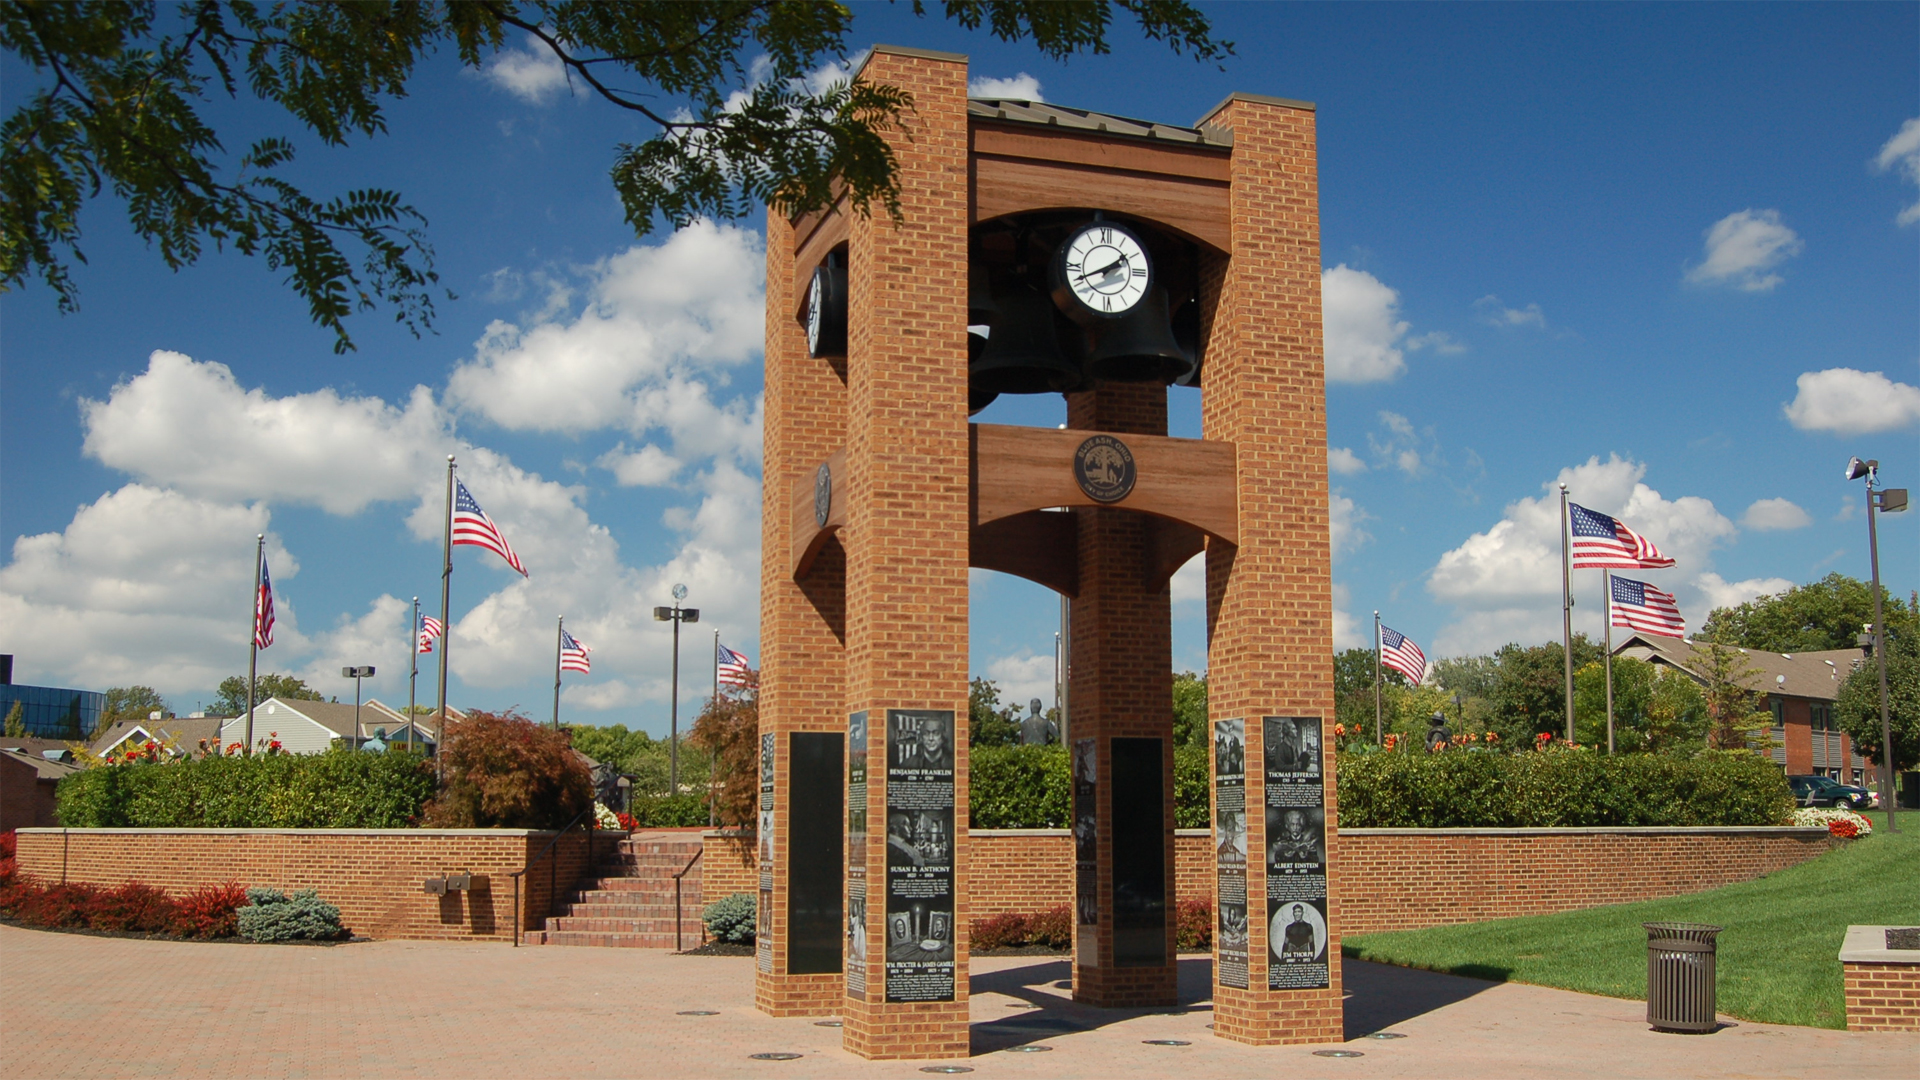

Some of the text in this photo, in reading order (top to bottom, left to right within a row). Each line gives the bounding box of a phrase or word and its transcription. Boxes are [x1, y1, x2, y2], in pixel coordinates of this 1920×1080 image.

[1100, 227, 1112, 244] XII
[1132, 268, 1146, 277] III
[1078, 439, 1095, 458] BLUE
[1115, 442, 1131, 462] OHIO
[889, 768, 920, 776] BENJAMIN
